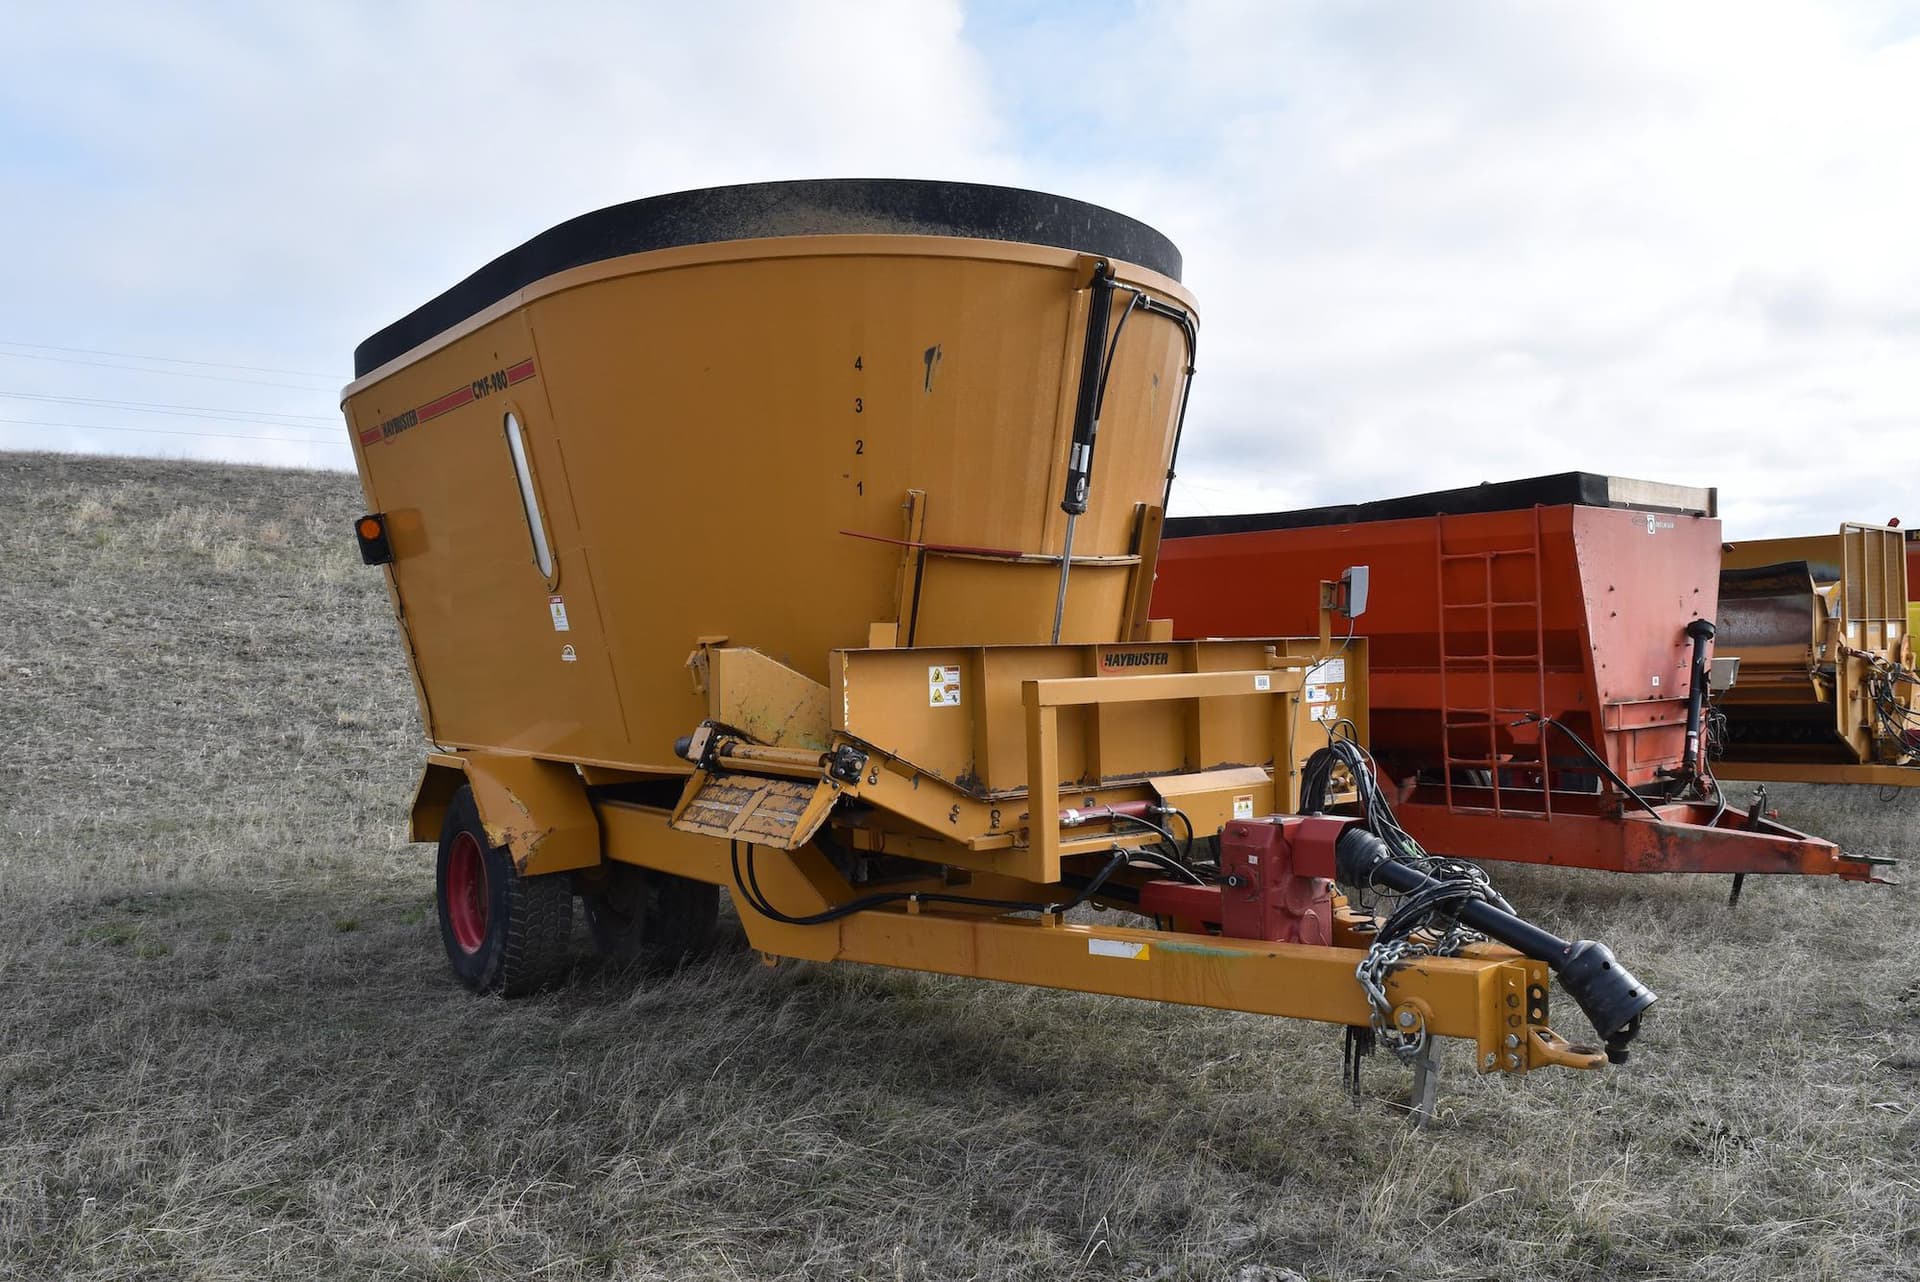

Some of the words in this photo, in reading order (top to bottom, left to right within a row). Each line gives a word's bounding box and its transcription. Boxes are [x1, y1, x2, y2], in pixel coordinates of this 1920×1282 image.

[855, 356, 863, 371] 4
[855, 398, 863, 413] 3
[856, 440, 863, 455] 2
[857, 481, 863, 496] 1
[1104, 652, 1168, 667] HAYBUSTER
